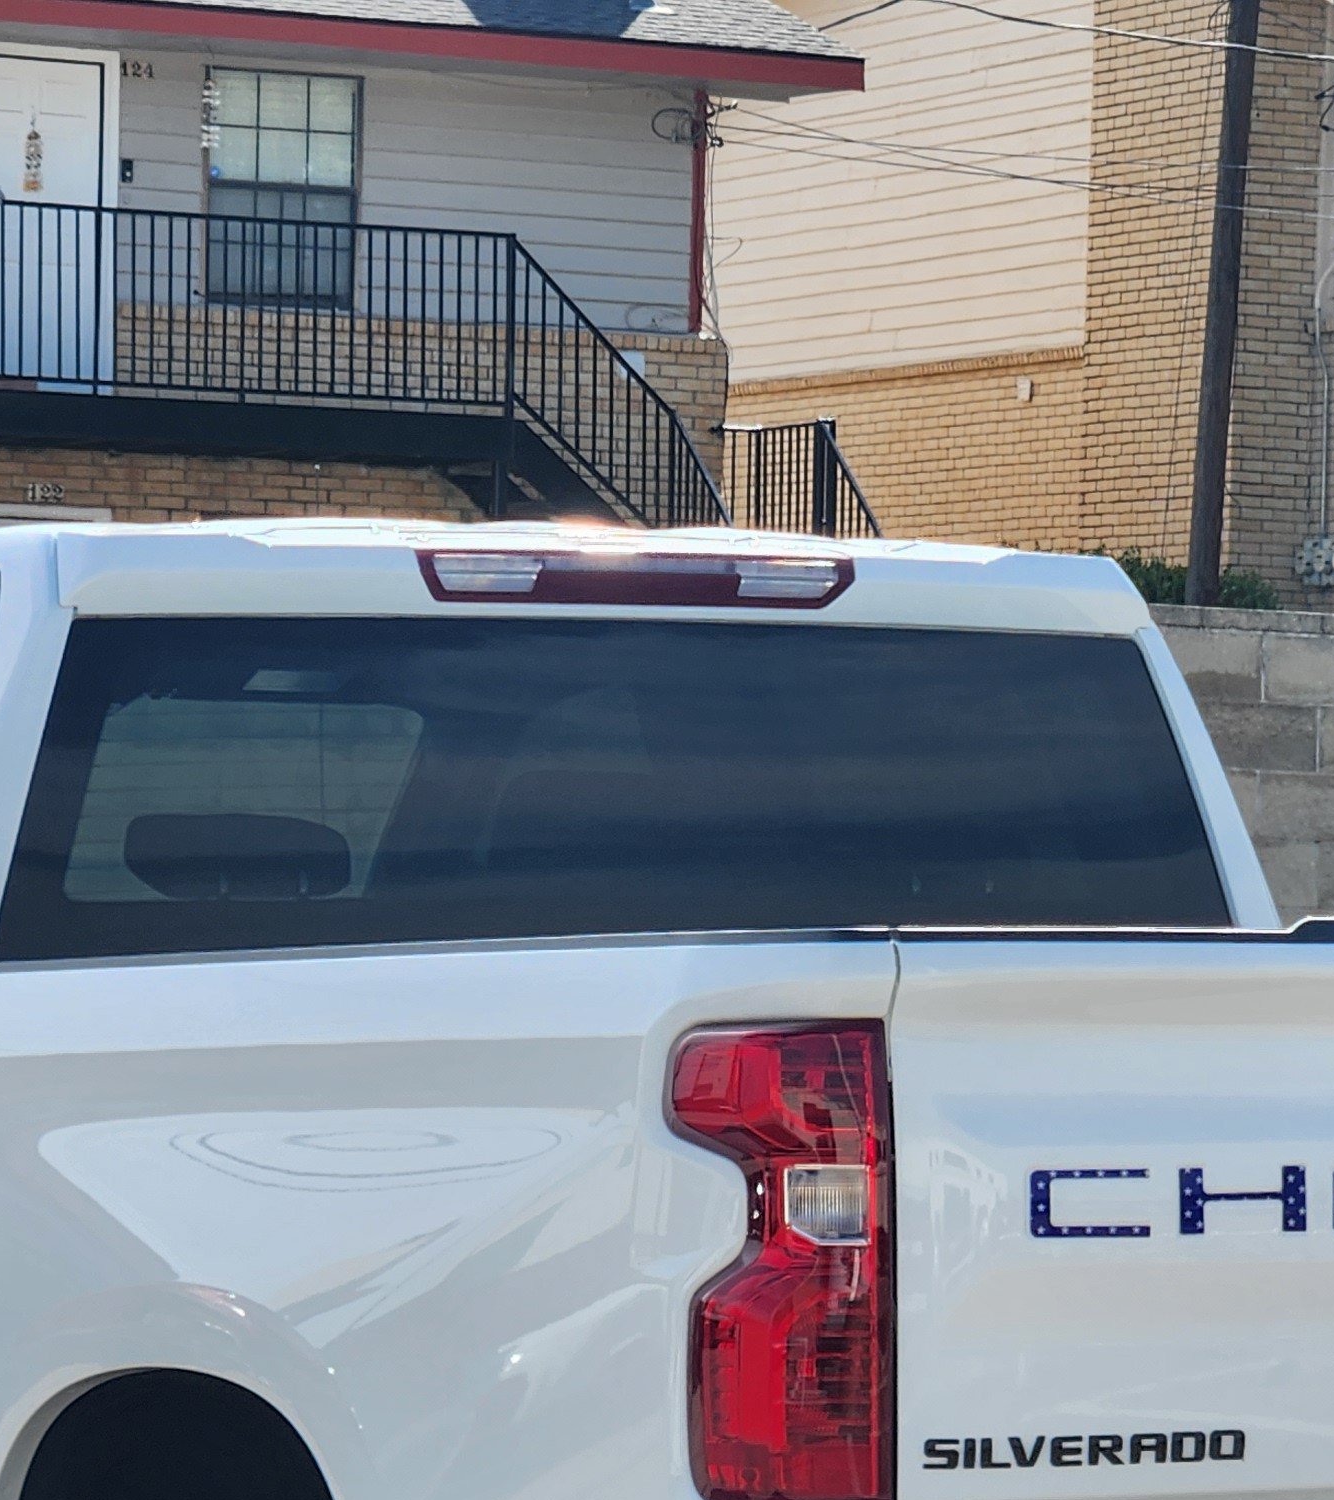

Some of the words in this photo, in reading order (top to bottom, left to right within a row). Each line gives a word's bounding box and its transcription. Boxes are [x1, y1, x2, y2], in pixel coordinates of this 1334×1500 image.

[121, 60, 154, 79] 124
[28, 483, 65, 503] 122
[922, 1429, 1246, 1470] SILVERADO
